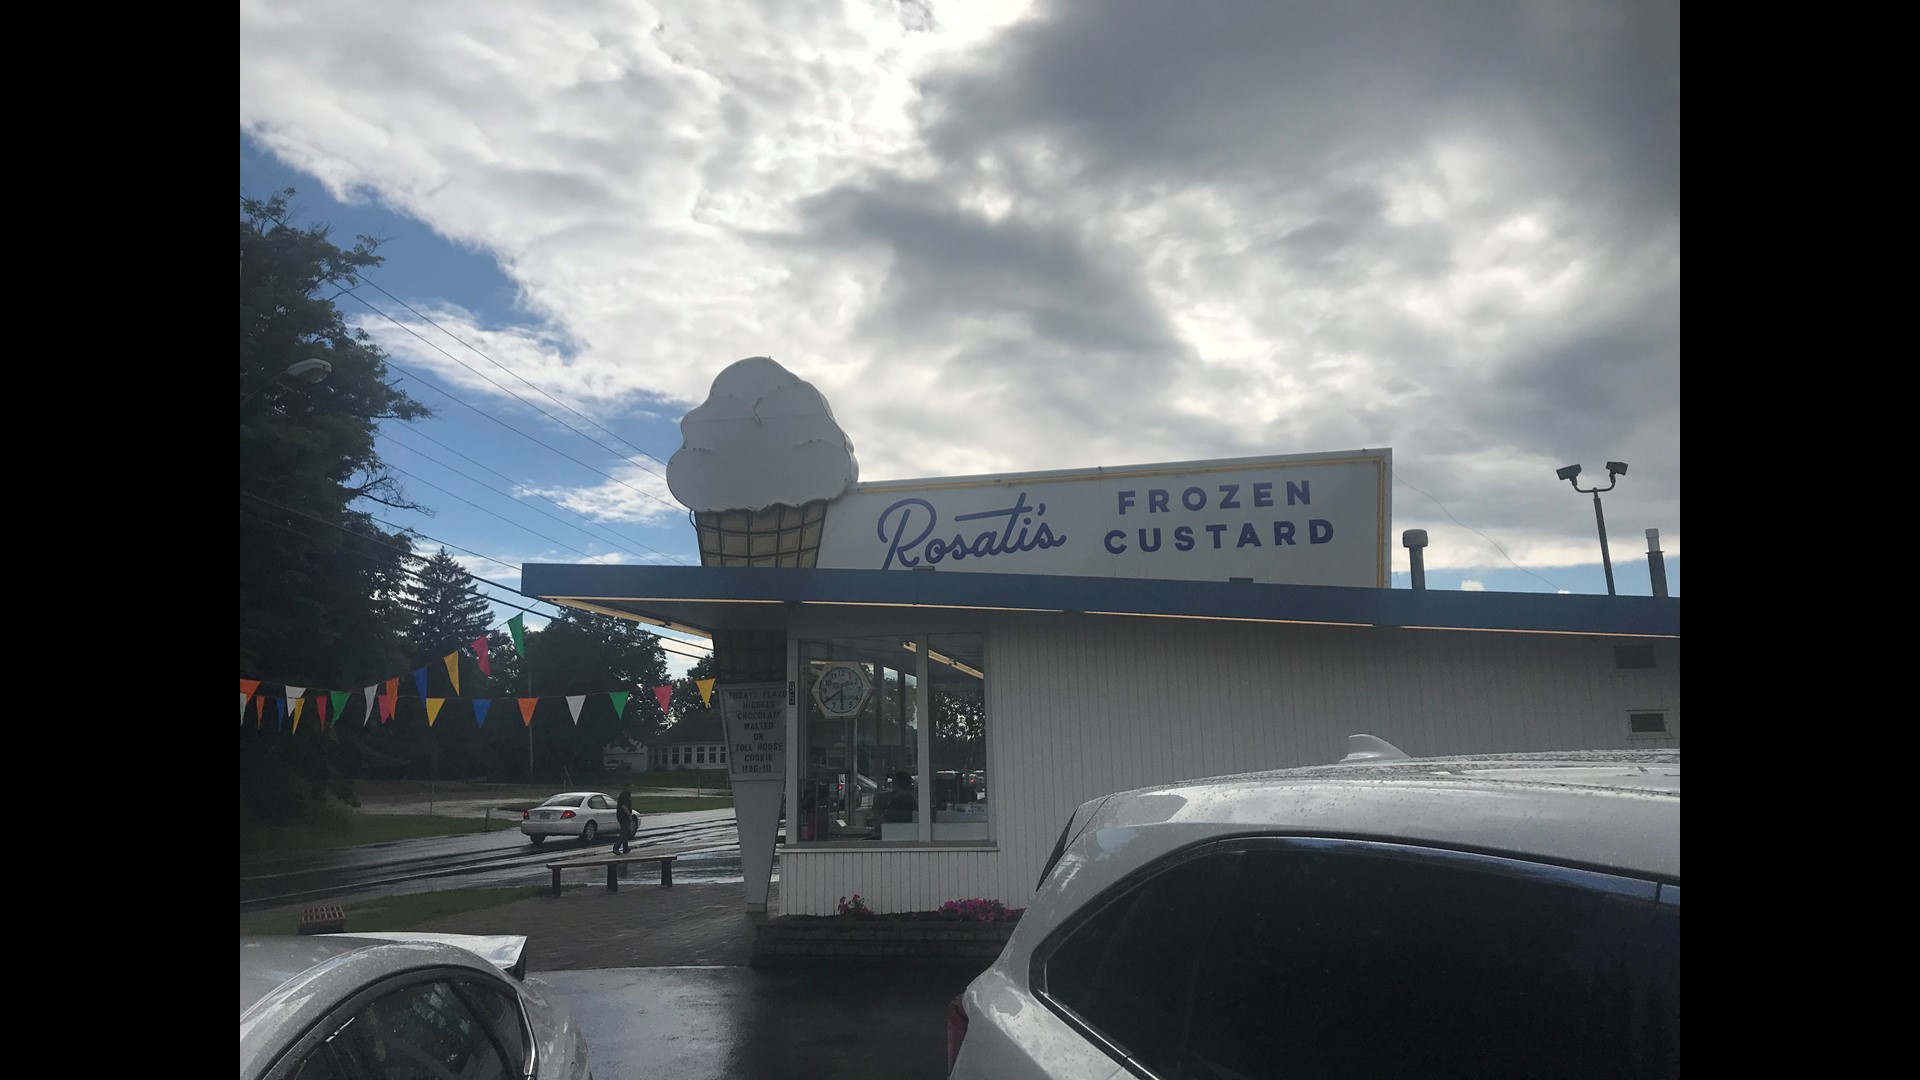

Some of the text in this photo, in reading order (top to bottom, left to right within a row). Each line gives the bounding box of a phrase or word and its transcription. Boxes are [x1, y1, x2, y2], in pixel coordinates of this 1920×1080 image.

[1118, 480, 1311, 515] FROZEN
[877, 492, 1067, 570] Rosati's
[1104, 518, 1335, 554] CUSTARD
[737, 711, 781, 720] CHOCOLATE
[744, 721, 774, 730] MALTED
[753, 732, 764, 741] OR
[735, 742, 783, 752] TOLL HOUSE
[744, 753, 773, 762] COOKIE
